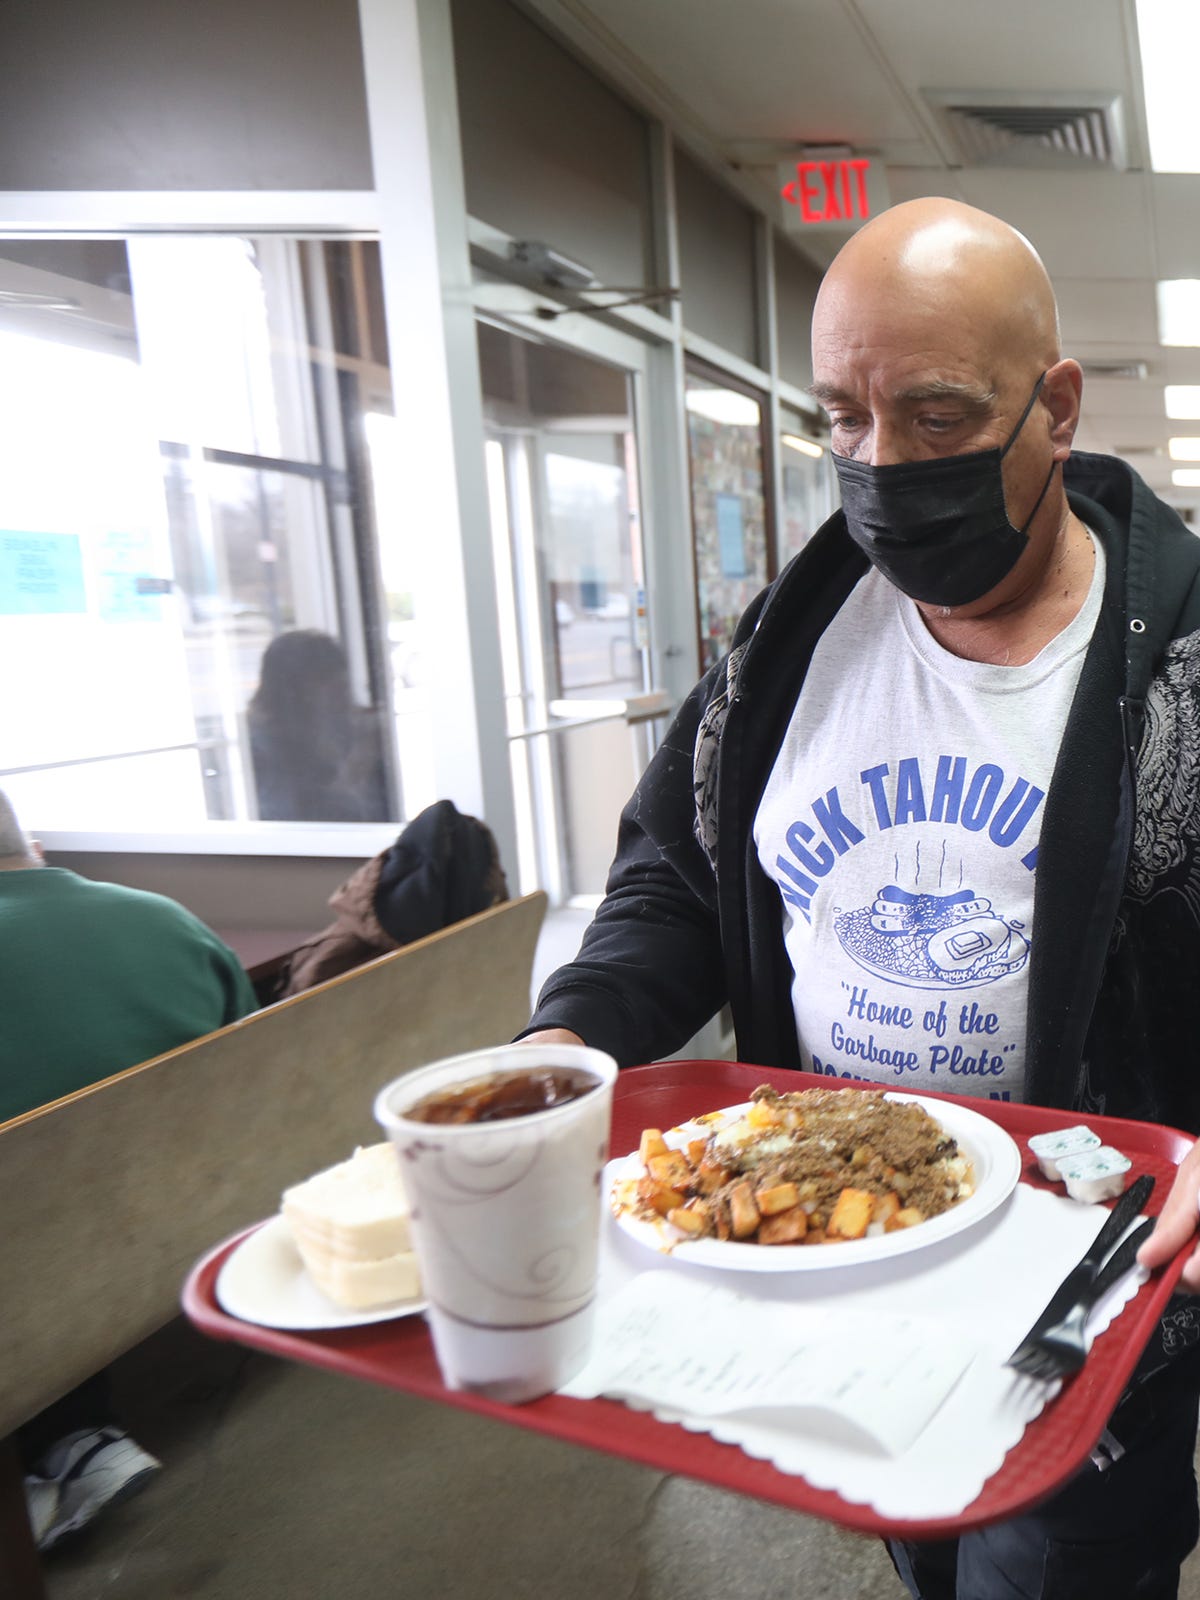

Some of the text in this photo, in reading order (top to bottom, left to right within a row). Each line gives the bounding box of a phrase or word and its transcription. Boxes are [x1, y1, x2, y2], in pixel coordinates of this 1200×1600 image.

[797, 160, 870, 223] EXIT
[860, 755, 1045, 872] TAHOU
[923, 1001, 947, 1037] of
[959, 1003, 999, 1034] the
[831, 1022, 919, 1075] Garbage
